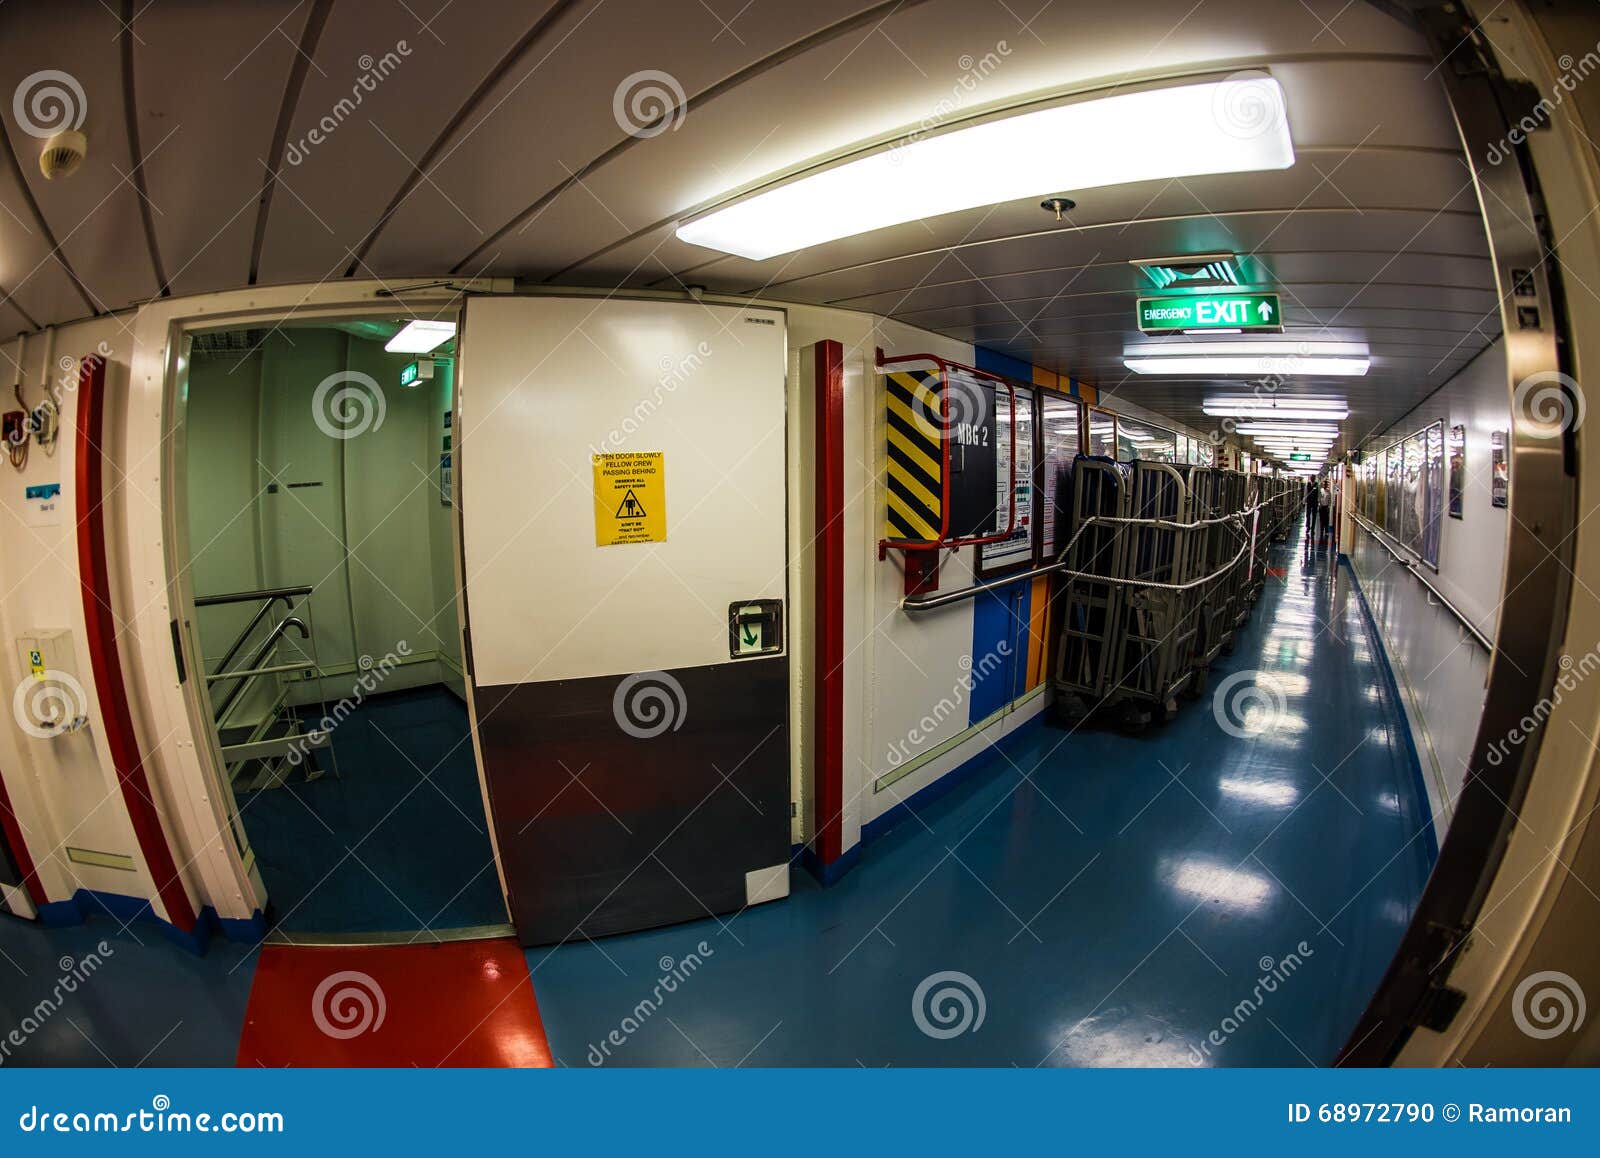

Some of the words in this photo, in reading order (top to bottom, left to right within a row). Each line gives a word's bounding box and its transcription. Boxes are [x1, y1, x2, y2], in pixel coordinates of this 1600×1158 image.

[1144, 308, 1191, 321] EMERGENCY
[1195, 301, 1251, 323] EXIT
[957, 422, 978, 446] MBG
[982, 426, 988, 447] 2
